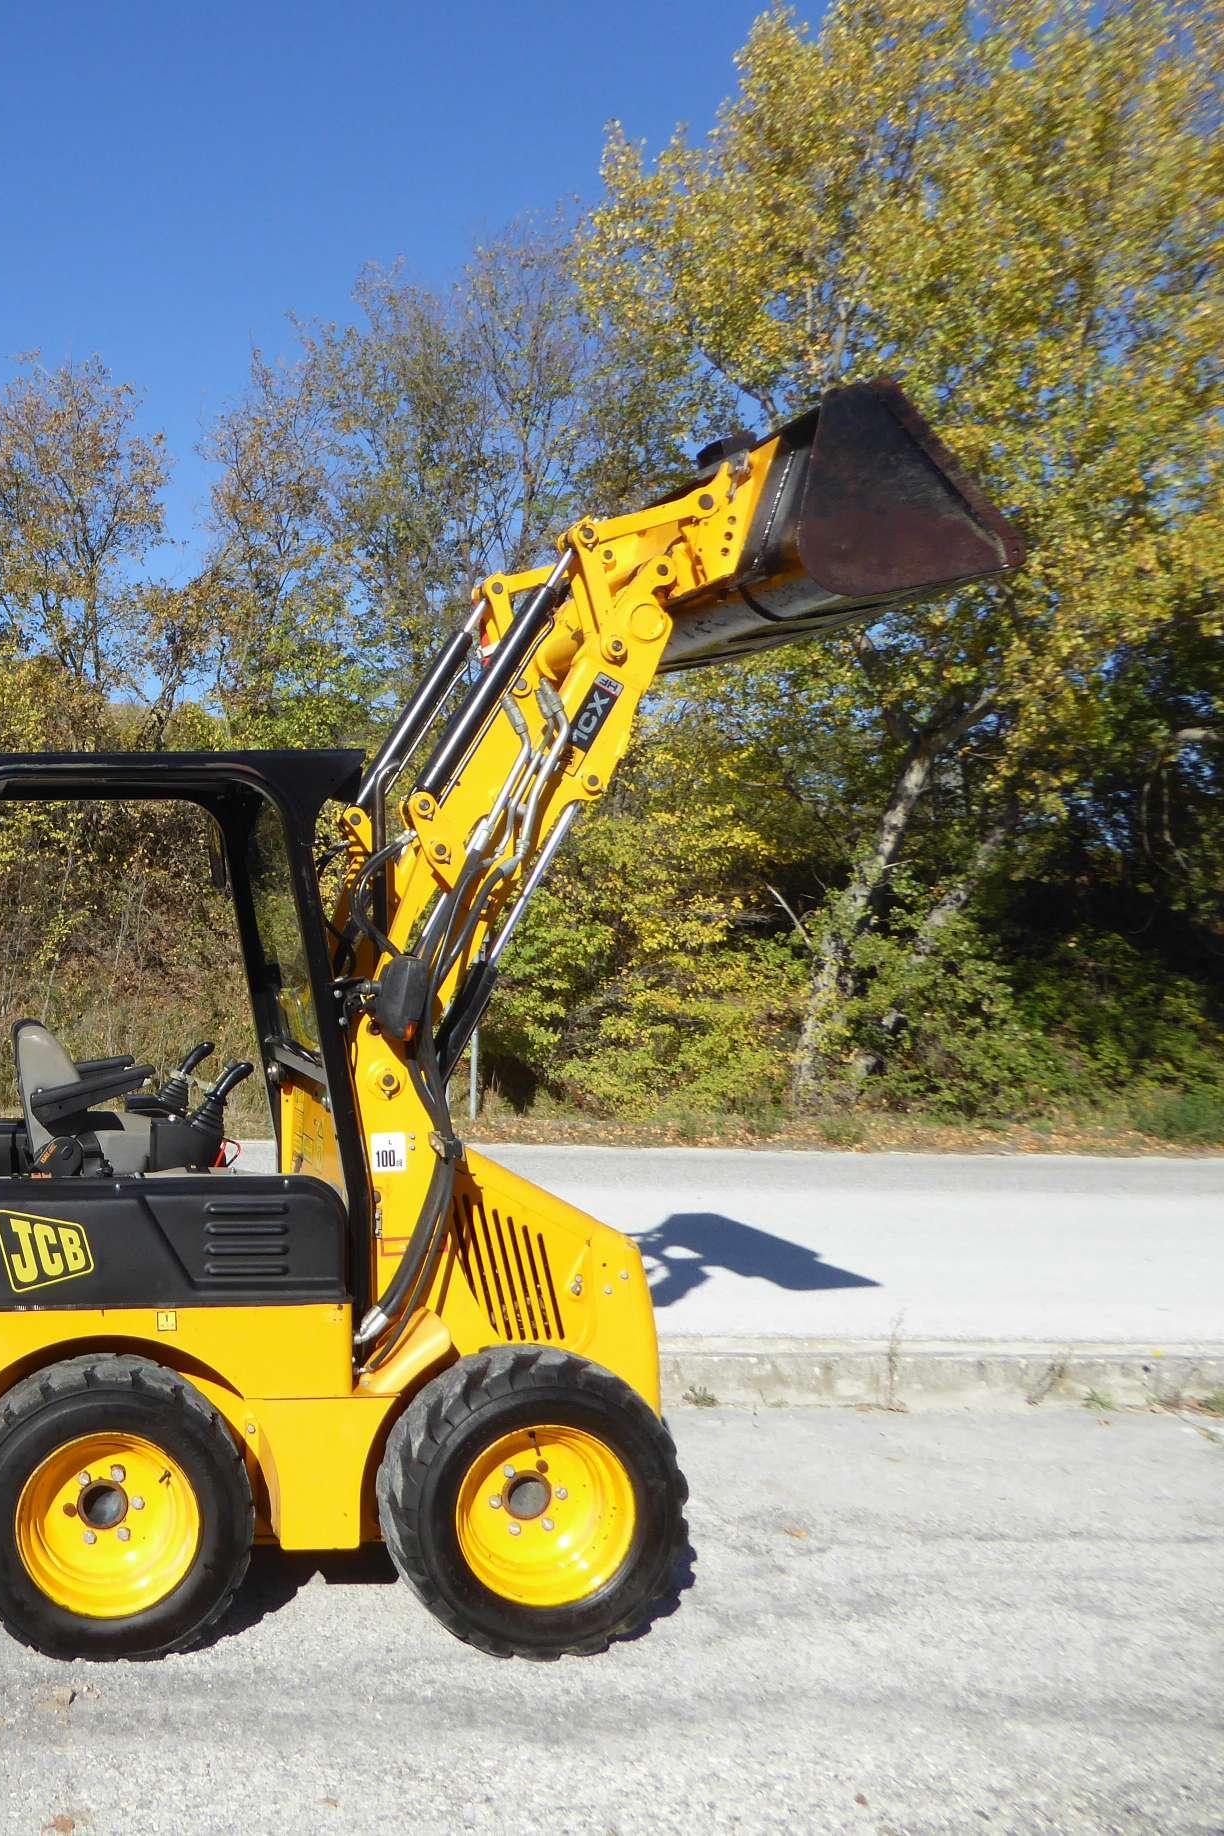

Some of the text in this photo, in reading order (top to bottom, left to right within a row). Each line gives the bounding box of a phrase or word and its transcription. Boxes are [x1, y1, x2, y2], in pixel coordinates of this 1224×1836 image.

[597, 678, 619, 692] HF
[572, 691, 610, 743] 1CX
[376, 1149, 396, 1168] 100
[9, 1218, 86, 1283] JCB
